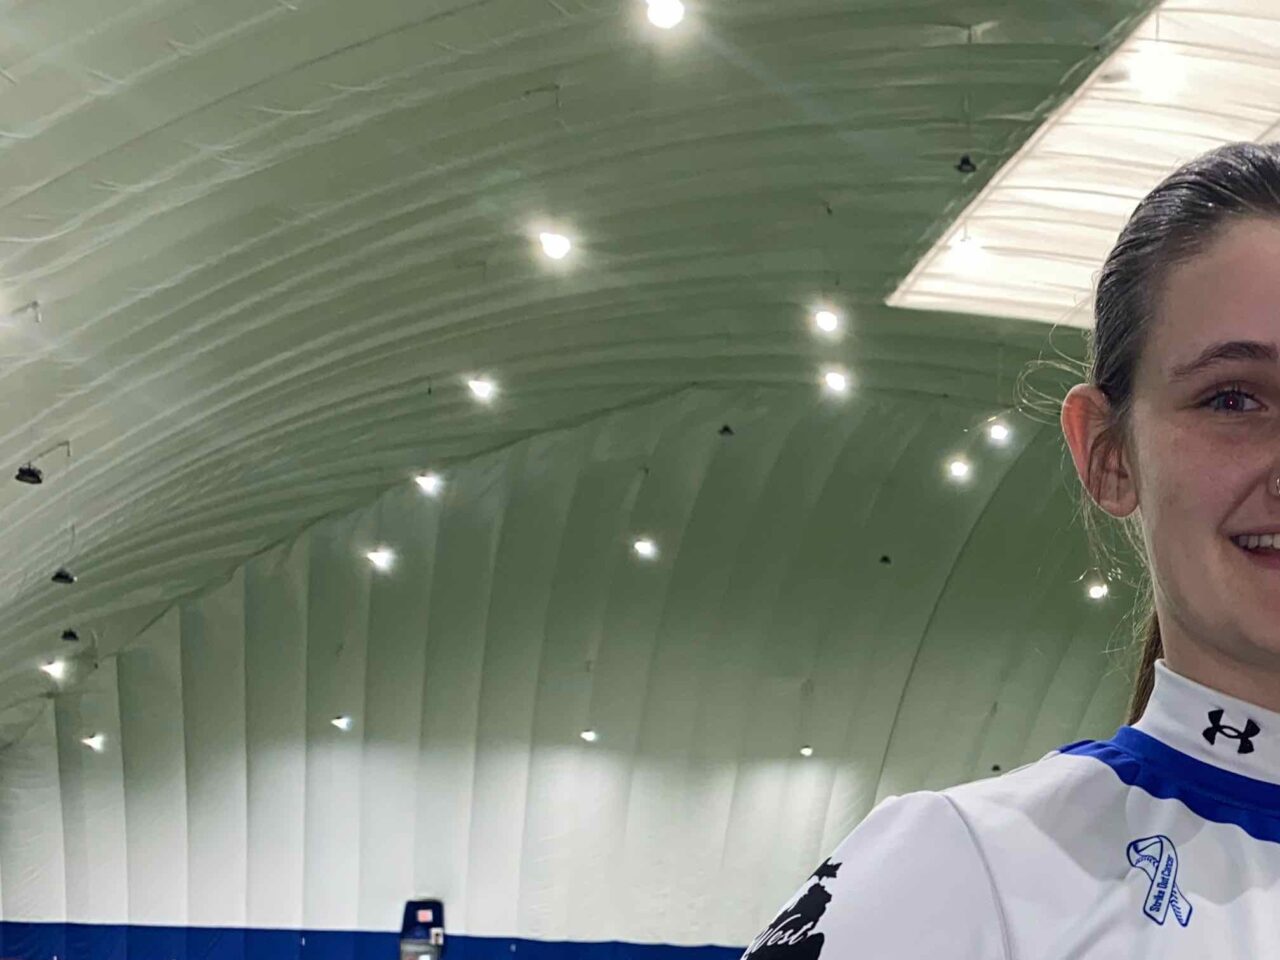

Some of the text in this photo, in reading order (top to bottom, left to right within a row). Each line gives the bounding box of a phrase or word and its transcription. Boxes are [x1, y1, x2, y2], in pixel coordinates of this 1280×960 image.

[1150, 855, 1173, 912] Strike Out Cancer
